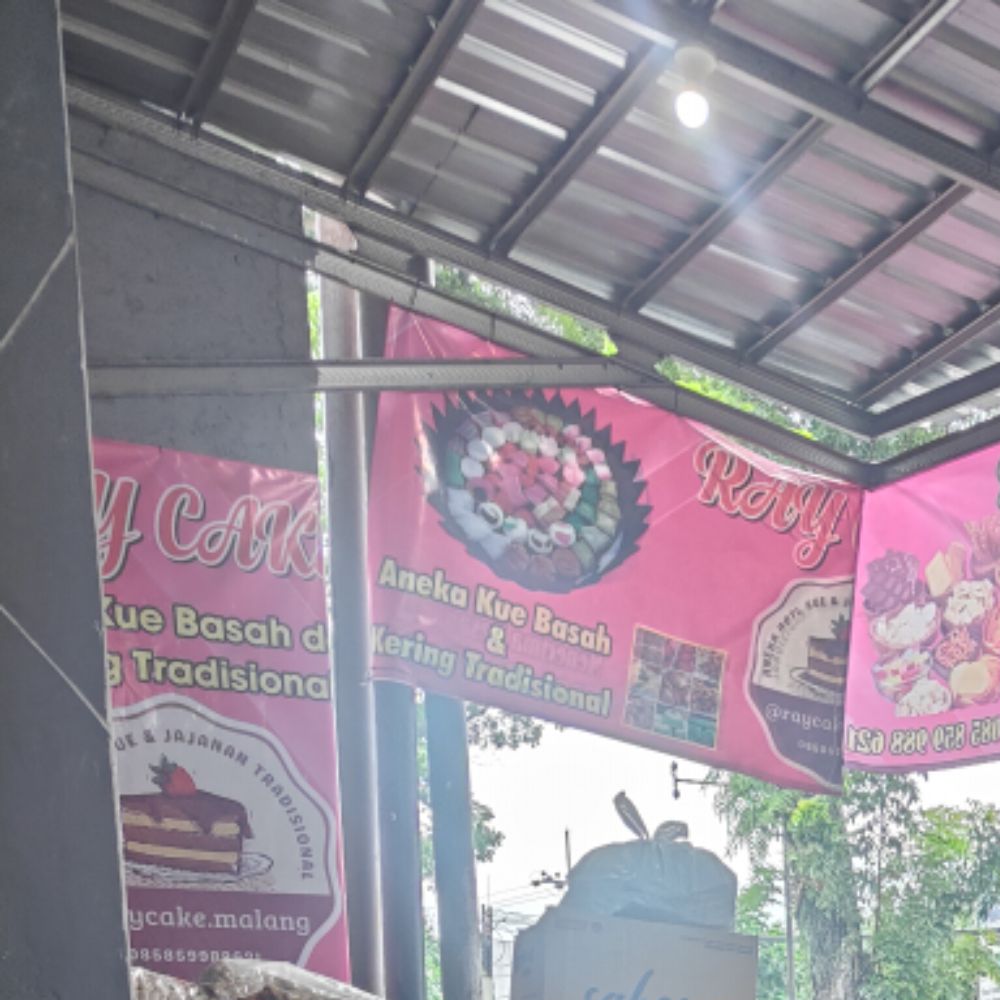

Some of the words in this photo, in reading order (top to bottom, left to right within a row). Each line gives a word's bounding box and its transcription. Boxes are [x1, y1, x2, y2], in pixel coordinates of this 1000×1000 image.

[155, 484, 328, 580] CAK
[173, 603, 293, 648] Basah
[378, 556, 468, 608] Aneka
[475, 584, 528, 627] Kue
[532, 603, 612, 656] Basah
[486, 624, 507, 657] &
[131, 649, 331, 699] Tradisiona
[371, 624, 456, 678] Kering
[464, 650, 612, 718] Tradisional
[164, 729, 248, 766] JAJANAN
[253, 763, 313, 880] TRADISIONAL
